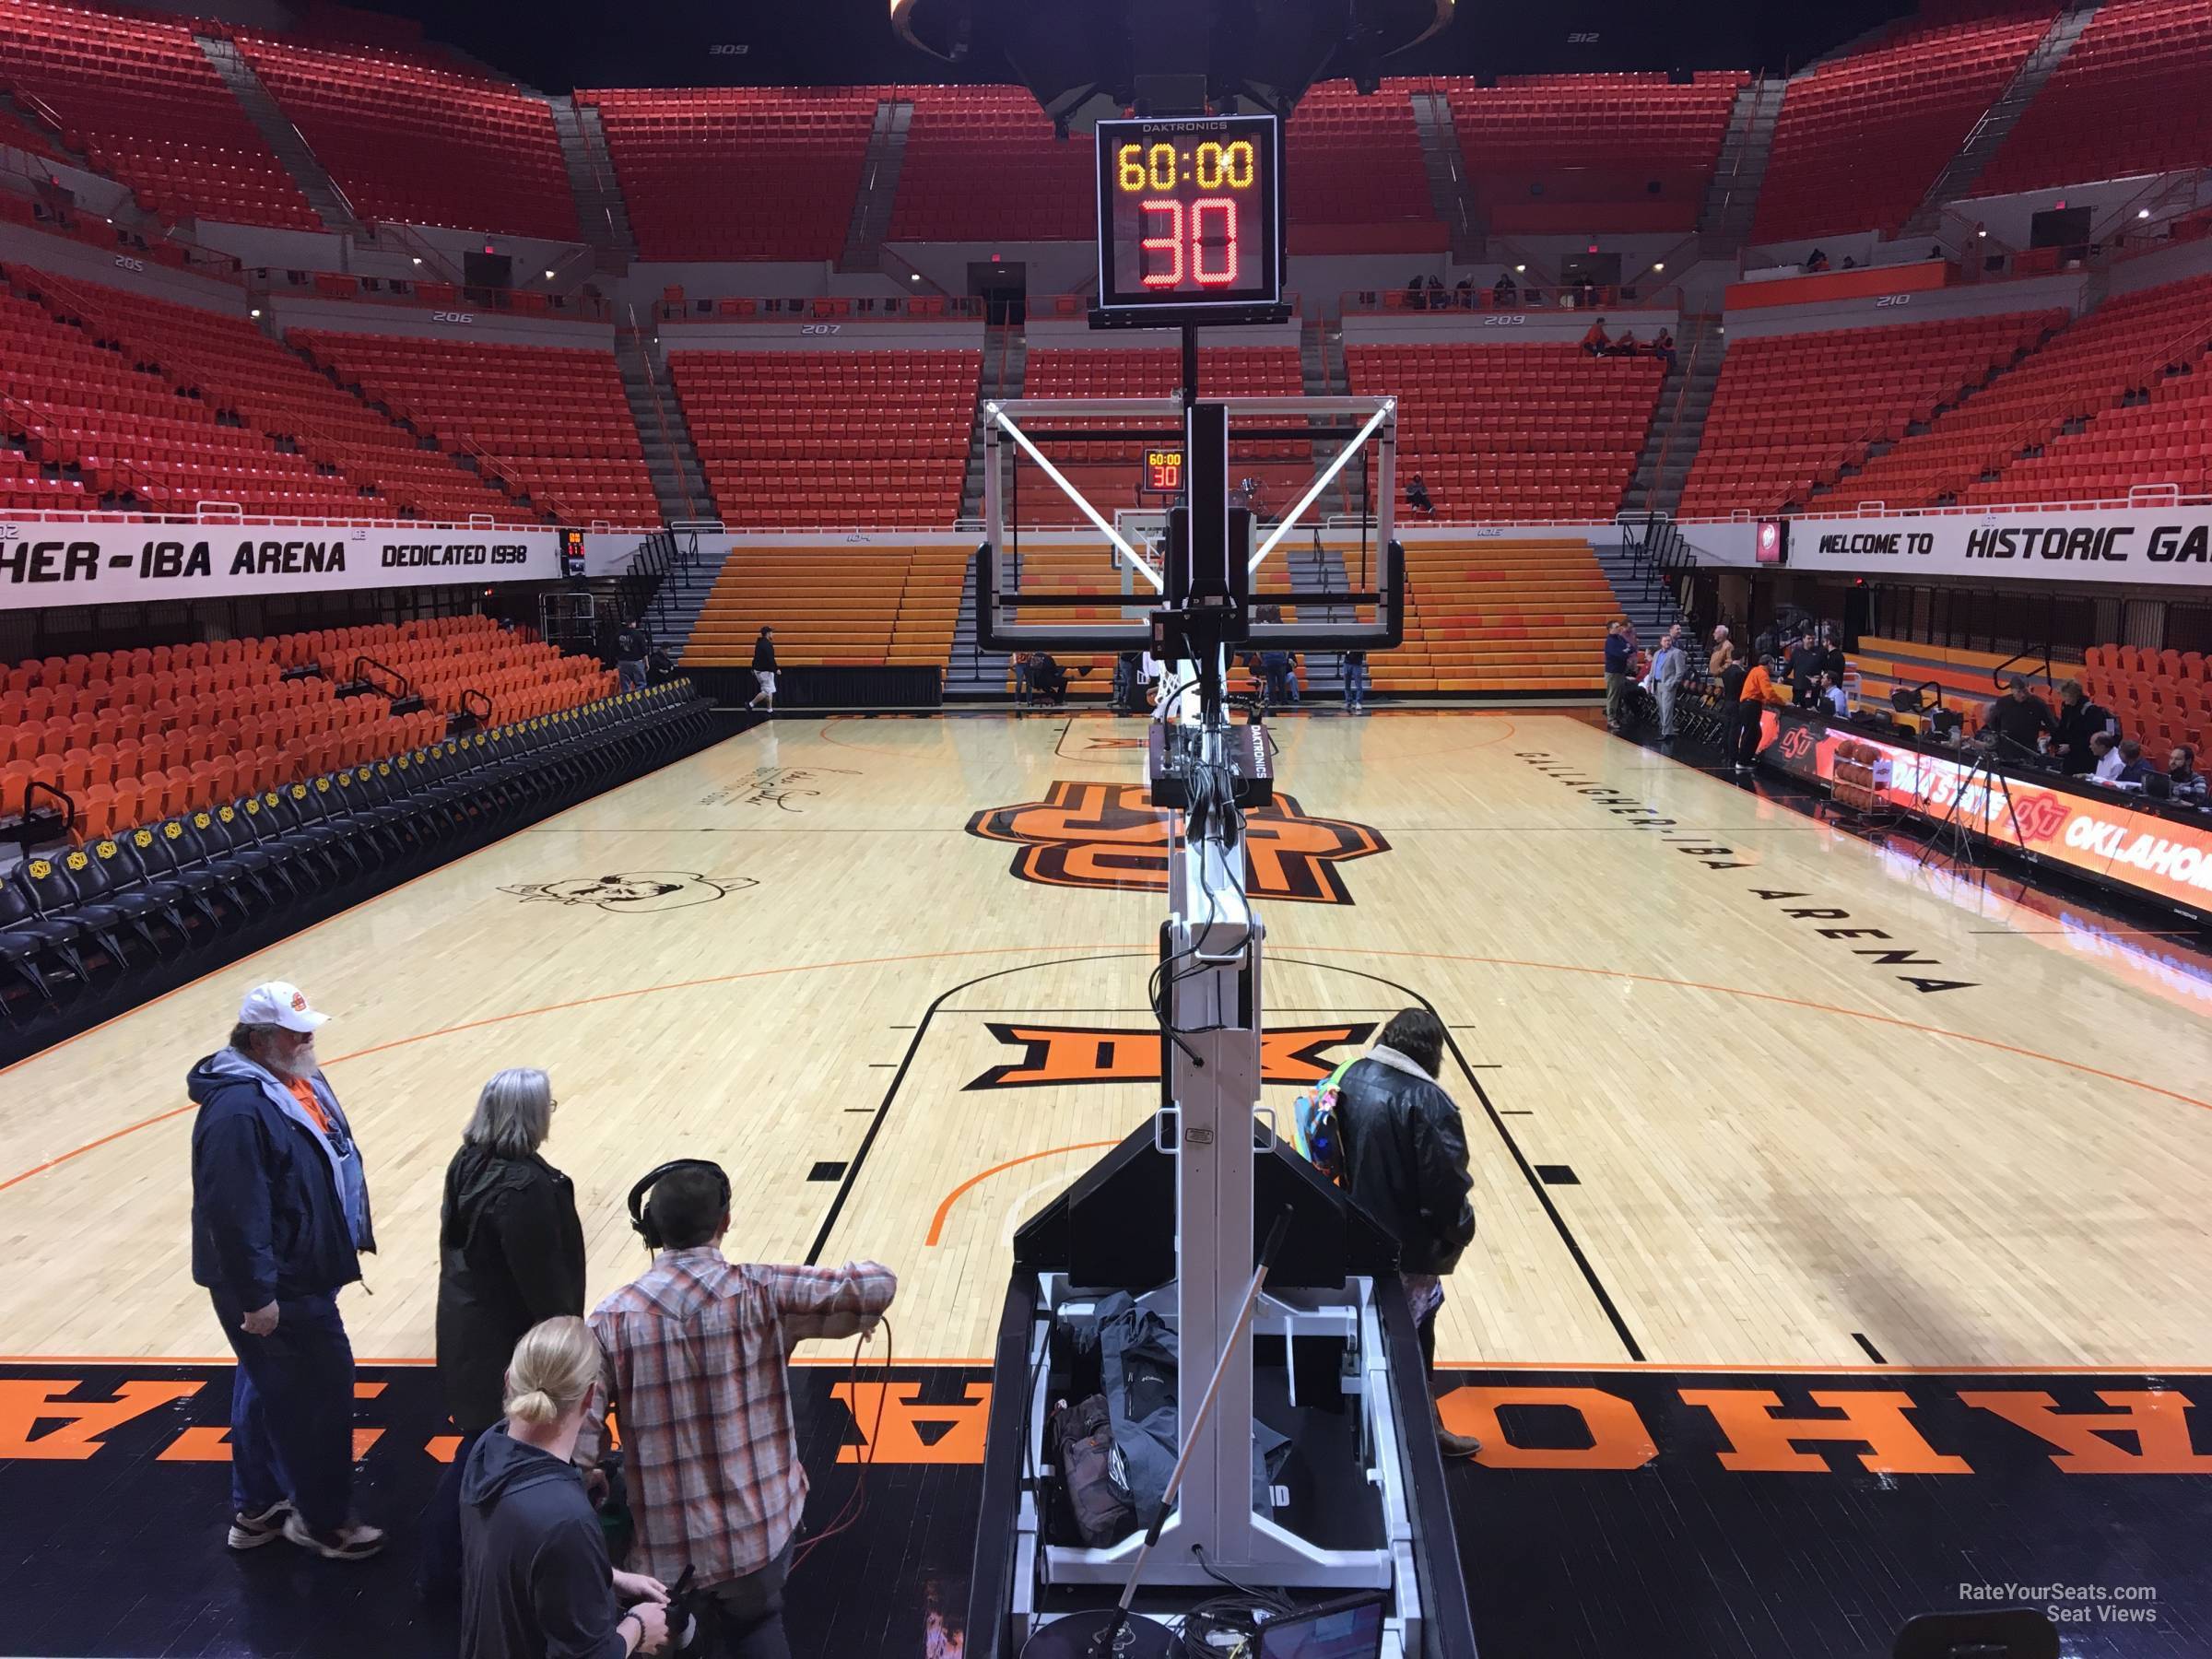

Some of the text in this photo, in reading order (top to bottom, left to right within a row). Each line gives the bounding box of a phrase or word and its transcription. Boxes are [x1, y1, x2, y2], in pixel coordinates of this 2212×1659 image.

[1567, 32, 1600, 42] 312
[709, 44, 748, 54] 309
[1143, 122, 1228, 133] DAKTRONICS
[1118, 140, 1253, 191] 60:00
[1140, 197, 1237, 287] 30
[115, 254, 144, 272] 205
[1877, 294, 1911, 307] 210
[433, 311, 474, 324] 206
[1484, 315, 1526, 325] 209
[802, 324, 841, 334] 207
[1149, 453, 1181, 465] 60:00
[1154, 466, 1177, 487] 30
[1819, 533, 1934, 555] WELCOME TO
[1966, 526, 2135, 561] HISTORIC
[229, 541, 346, 576] ARENA
[381, 545, 527, 567] DEDICATED 1938
[1251, 724, 1267, 779] DAKTRONICS
[1747, 888, 1983, 993] ARENA
